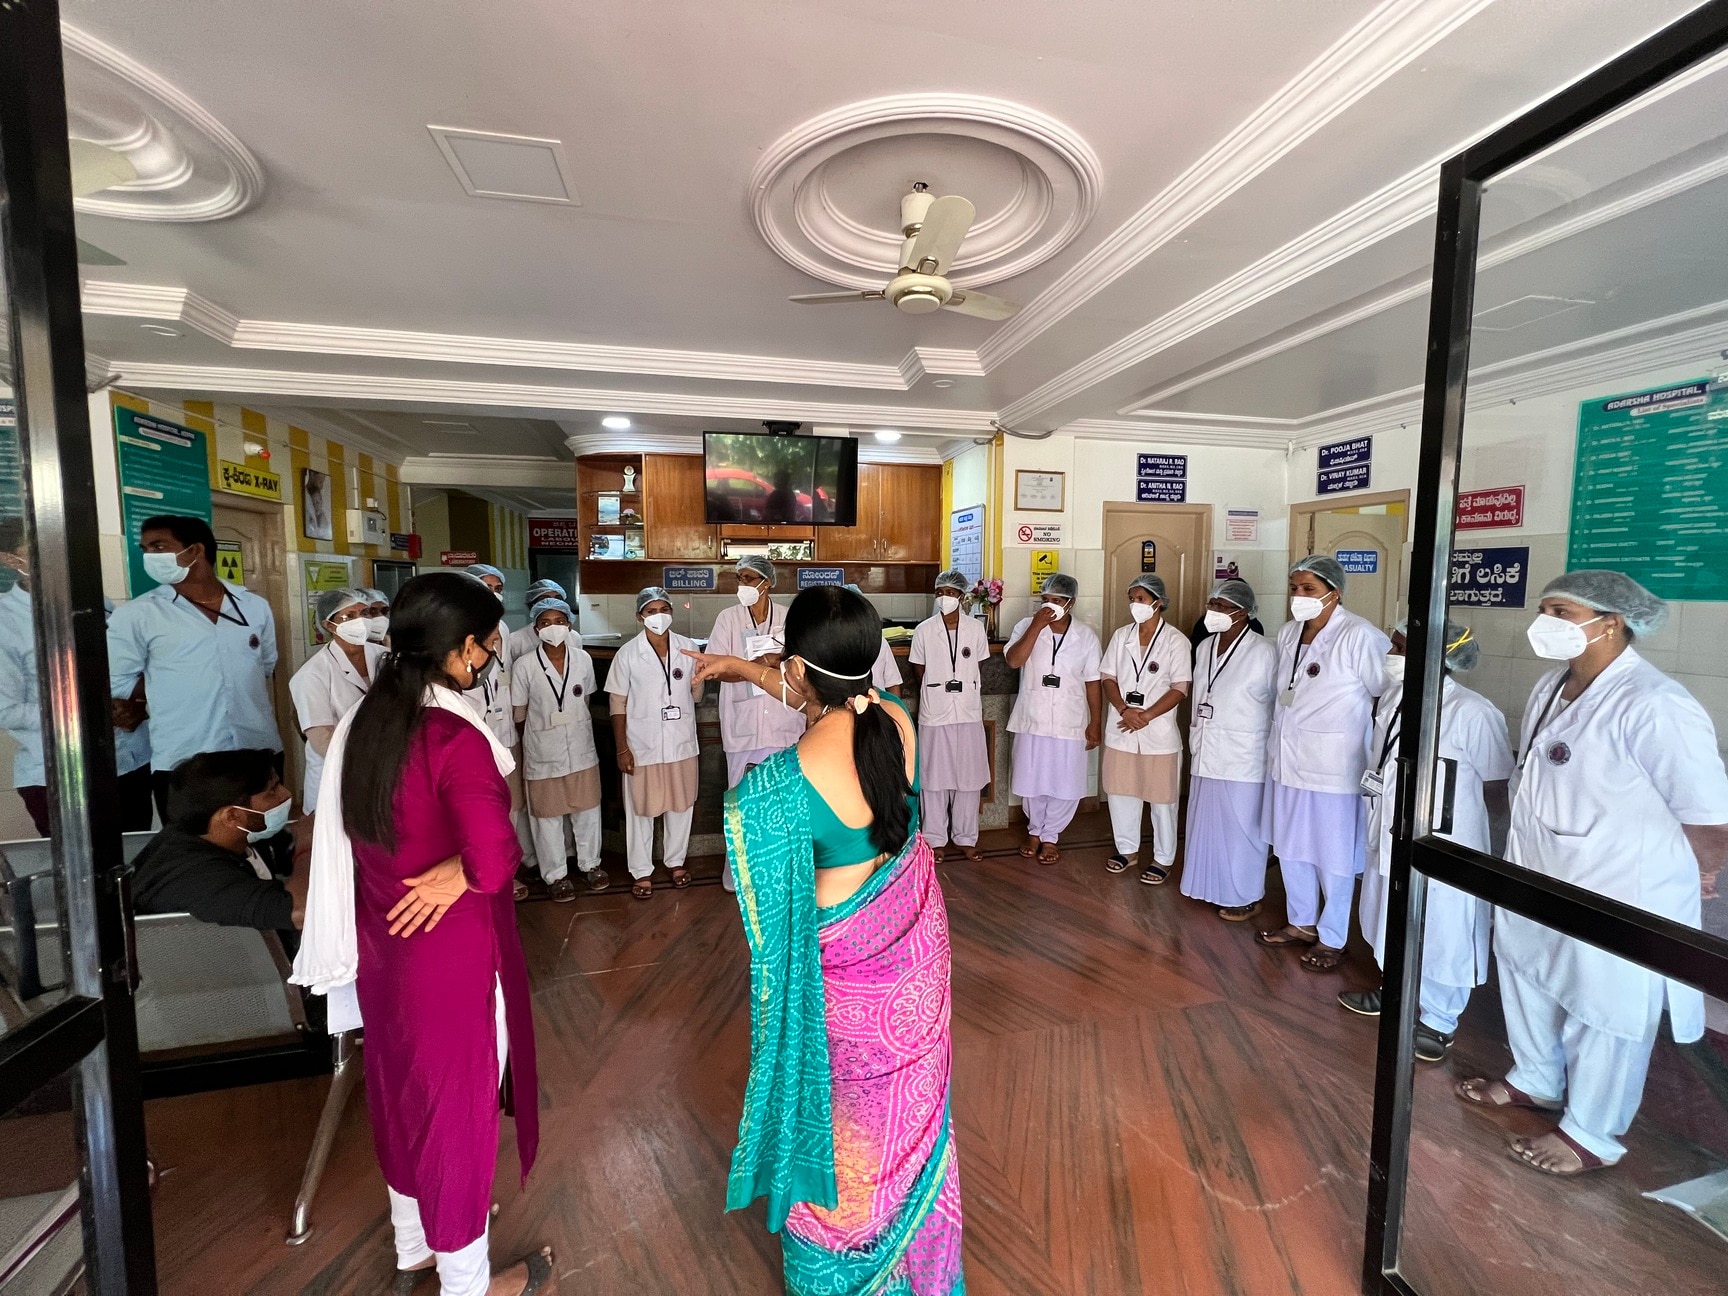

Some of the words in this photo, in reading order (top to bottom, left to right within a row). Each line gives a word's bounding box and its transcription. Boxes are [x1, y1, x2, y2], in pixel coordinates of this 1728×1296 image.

[1607, 396, 1650, 410] ADARSHA
[1331, 445, 1350, 454] POOJA
[1352, 441, 1368, 450] BHAT
[1329, 471, 1345, 480] VINAY
[1346, 467, 1367, 477] KUMAR
[254, 475, 278, 492] X-RAY
[533, 528, 577, 537] OPERATI
[1344, 564, 1374, 572] ASUALTY
[1476, 562, 1521, 584] ಲಸಿಕೆ
[1450, 587, 1506, 607] ಲಾಗುತ್ತದೆ.
